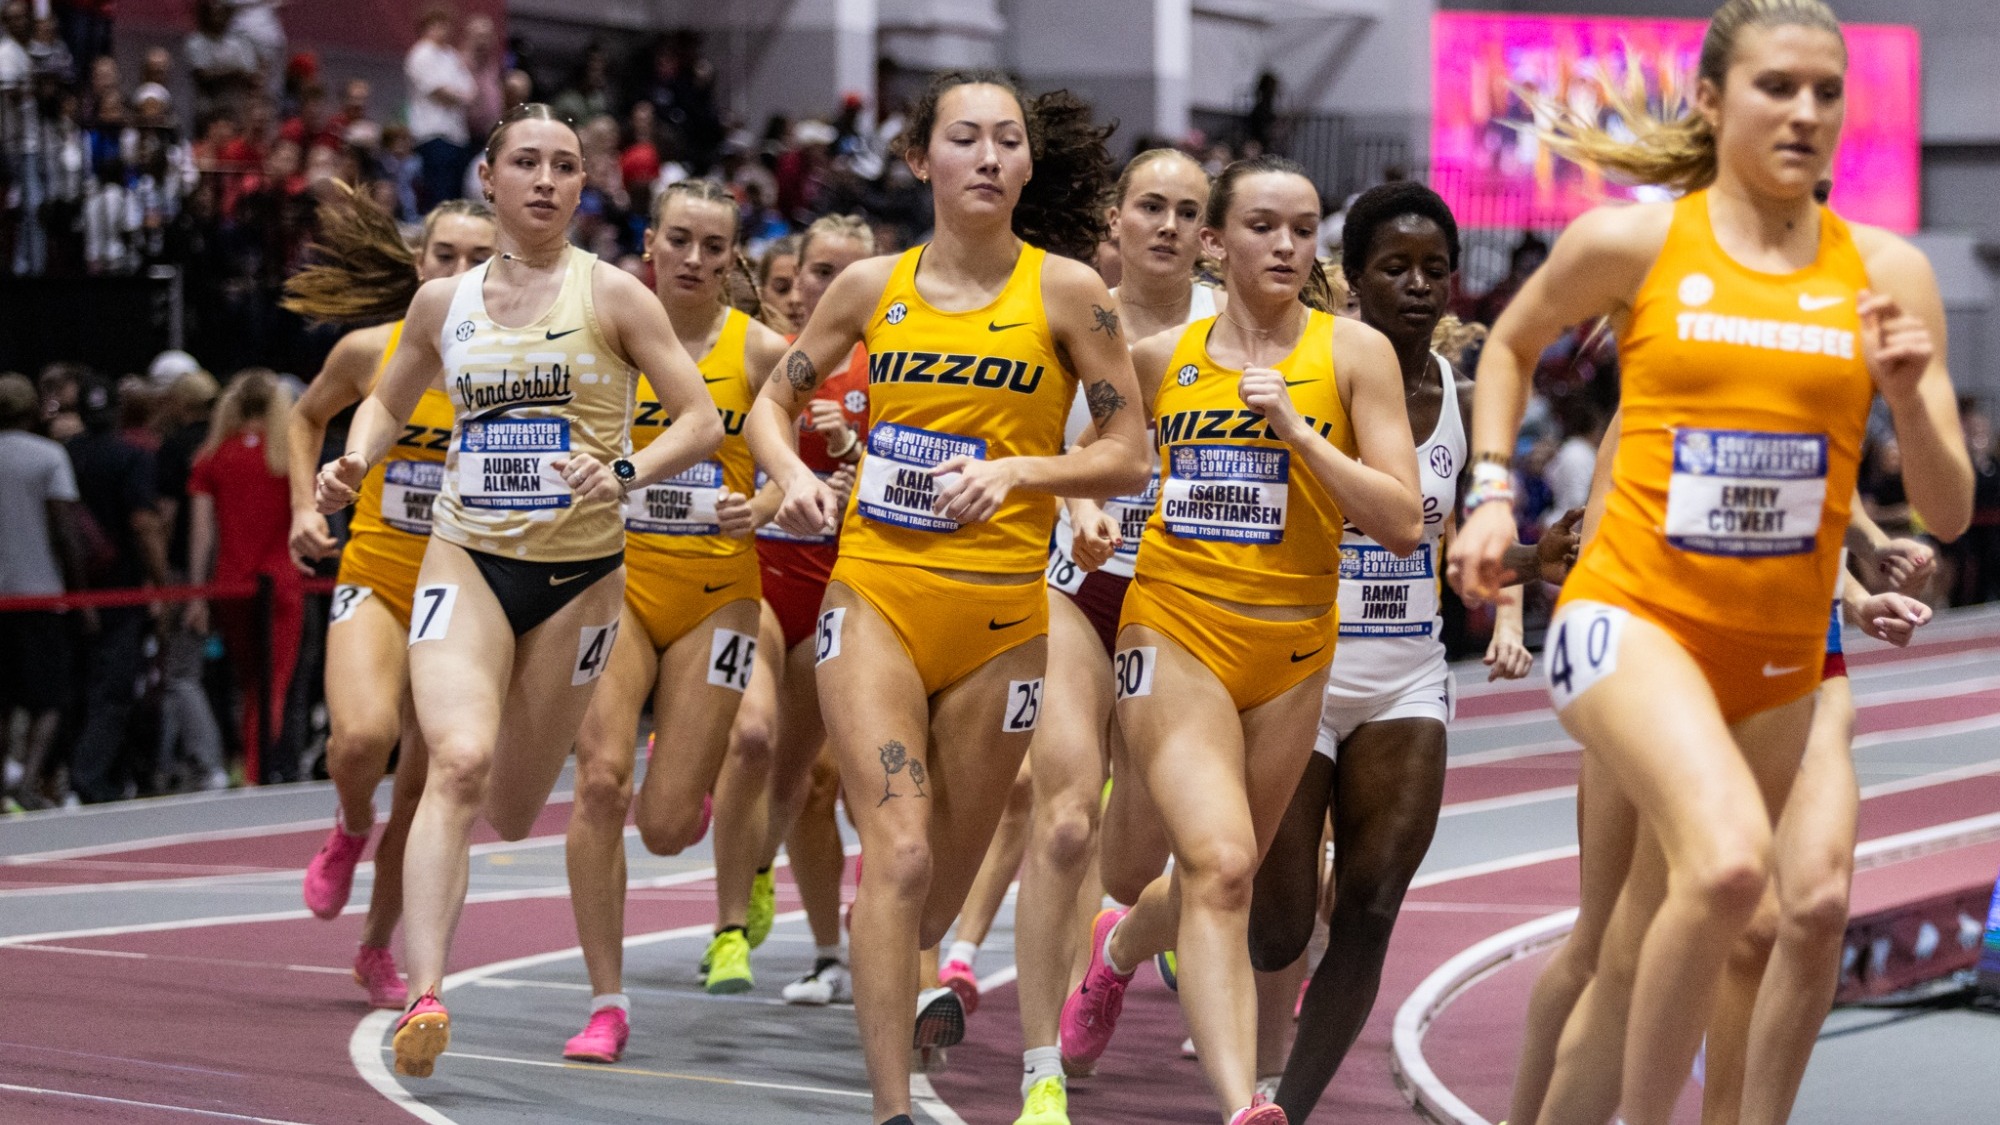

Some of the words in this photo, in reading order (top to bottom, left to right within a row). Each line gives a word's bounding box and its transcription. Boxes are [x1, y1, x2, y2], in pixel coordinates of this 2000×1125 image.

[1676, 311, 1855, 360] TENNESSEE
[869, 351, 1045, 395] MIZZOU
[457, 363, 571, 412] Vanderbilt
[487, 423, 560, 434] SOUTHEASTERN
[1160, 410, 1333, 446] MIZZ
[486, 433, 561, 445] CONFERENCE
[897, 430, 976, 455] SOUTHEASTERN
[483, 458, 540, 474] AUDREY
[1200, 450, 1280, 463] SOUTHEASTERN
[1430, 445, 1452, 478] SEC
[1200, 461, 1279, 474] CONFERENCE
[483, 475, 540, 492] ALLMAN
[896, 468, 933, 492] KAIA
[646, 489, 692, 506] NICOLE
[1189, 485, 1260, 505] ISABELLE
[1722, 485, 1780, 507] EMILY
[649, 504, 688, 519] LOUW
[1166, 500, 1281, 525] CHRISTIANSEN
[1708, 509, 1786, 533] COVERT
[1199, 527, 1220, 536] TYSON
[1222, 528, 1243, 538] TRACK
[1245, 530, 1270, 539] CENTER
[1363, 560, 1426, 572] CONFERENCE
[1362, 585, 1410, 601] RAMAT
[1362, 603, 1407, 619] JIMOH
[1551, 616, 1610, 693] 40
[1116, 649, 1144, 700] 30
[1010, 681, 1039, 729] 25
